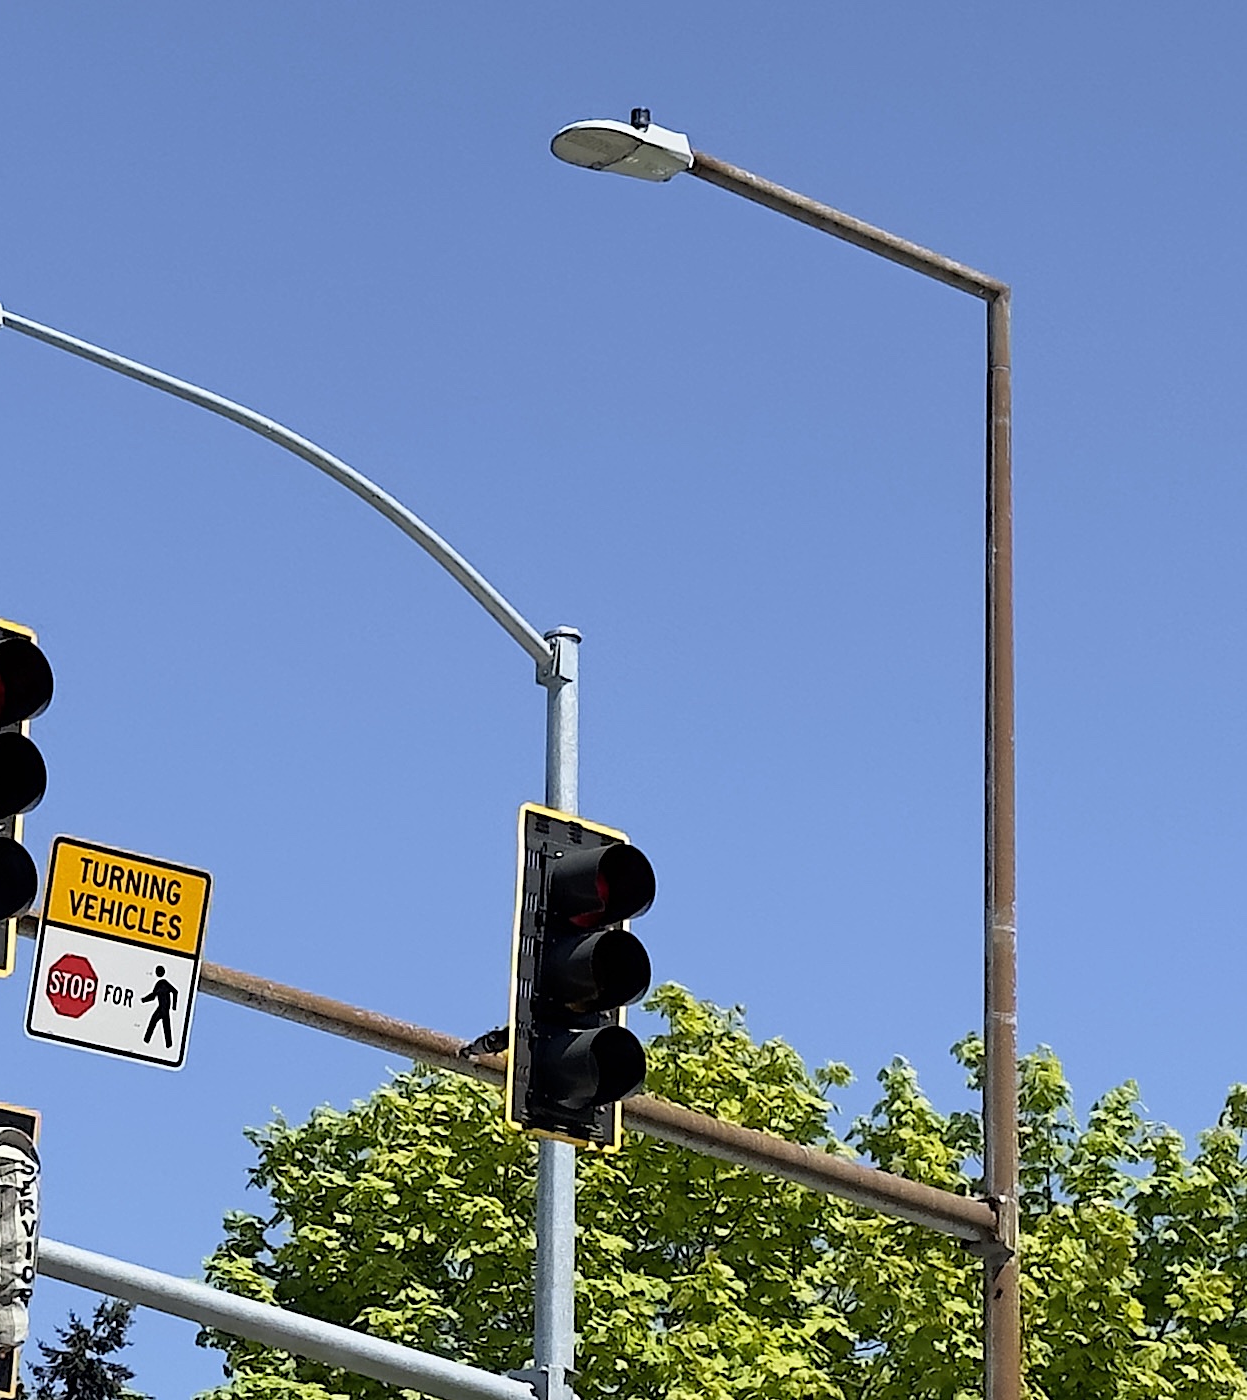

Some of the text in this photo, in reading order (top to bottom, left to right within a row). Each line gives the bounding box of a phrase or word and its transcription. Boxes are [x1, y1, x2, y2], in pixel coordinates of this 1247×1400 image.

[80, 856, 182, 906] TURNING
[69, 889, 182, 941] VEHICLES
[49, 970, 134, 1008] STOP FOR
